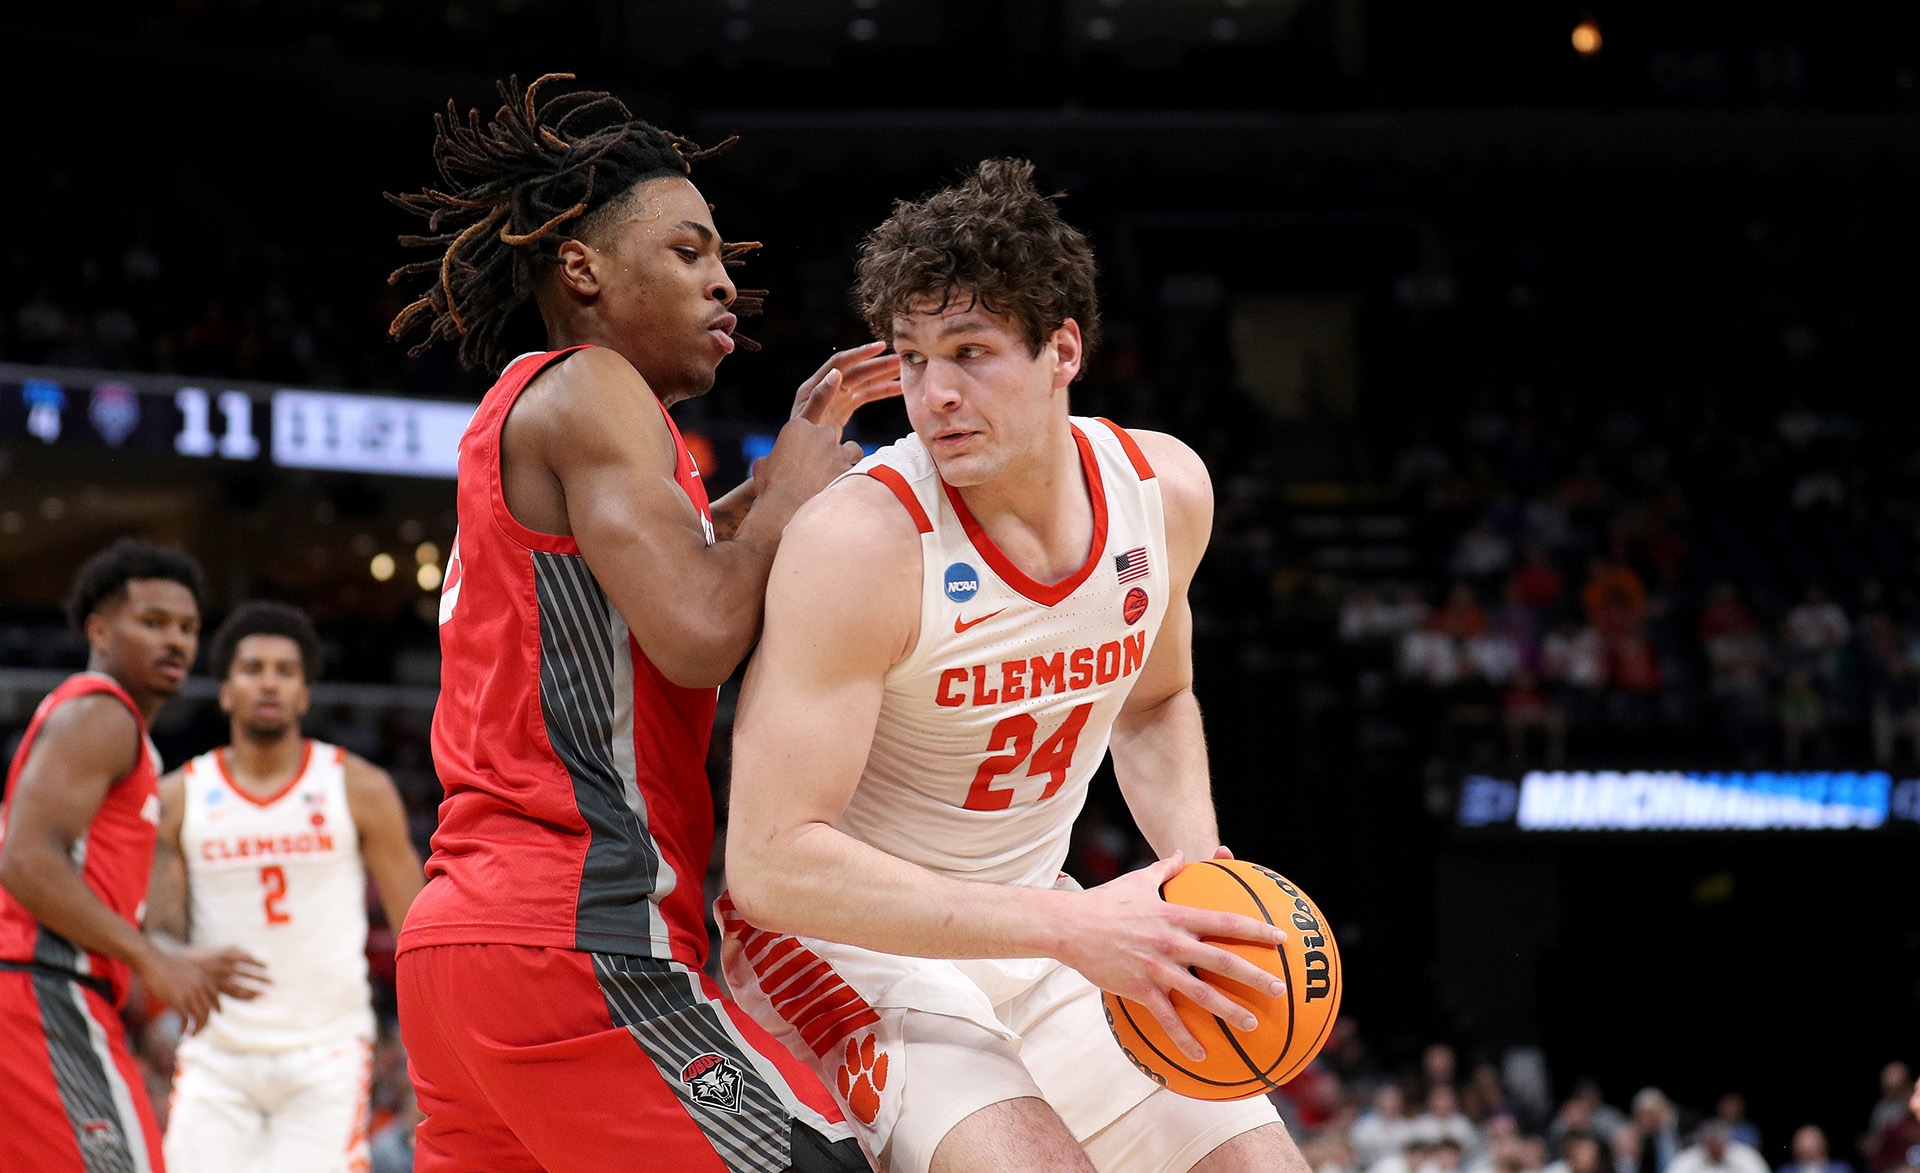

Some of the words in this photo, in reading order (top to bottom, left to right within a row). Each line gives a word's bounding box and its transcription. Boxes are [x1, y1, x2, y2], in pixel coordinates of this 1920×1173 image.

[175, 386, 258, 458] 11
[948, 580, 977, 593] NCAA
[935, 630, 1145, 707] CLEMSON
[962, 702, 1094, 811] 24
[203, 835, 335, 860] CLEMSON
[260, 865, 290, 924] 2
[1251, 864, 1331, 1003] Wilson
[683, 1055, 723, 1082] LOBOS
